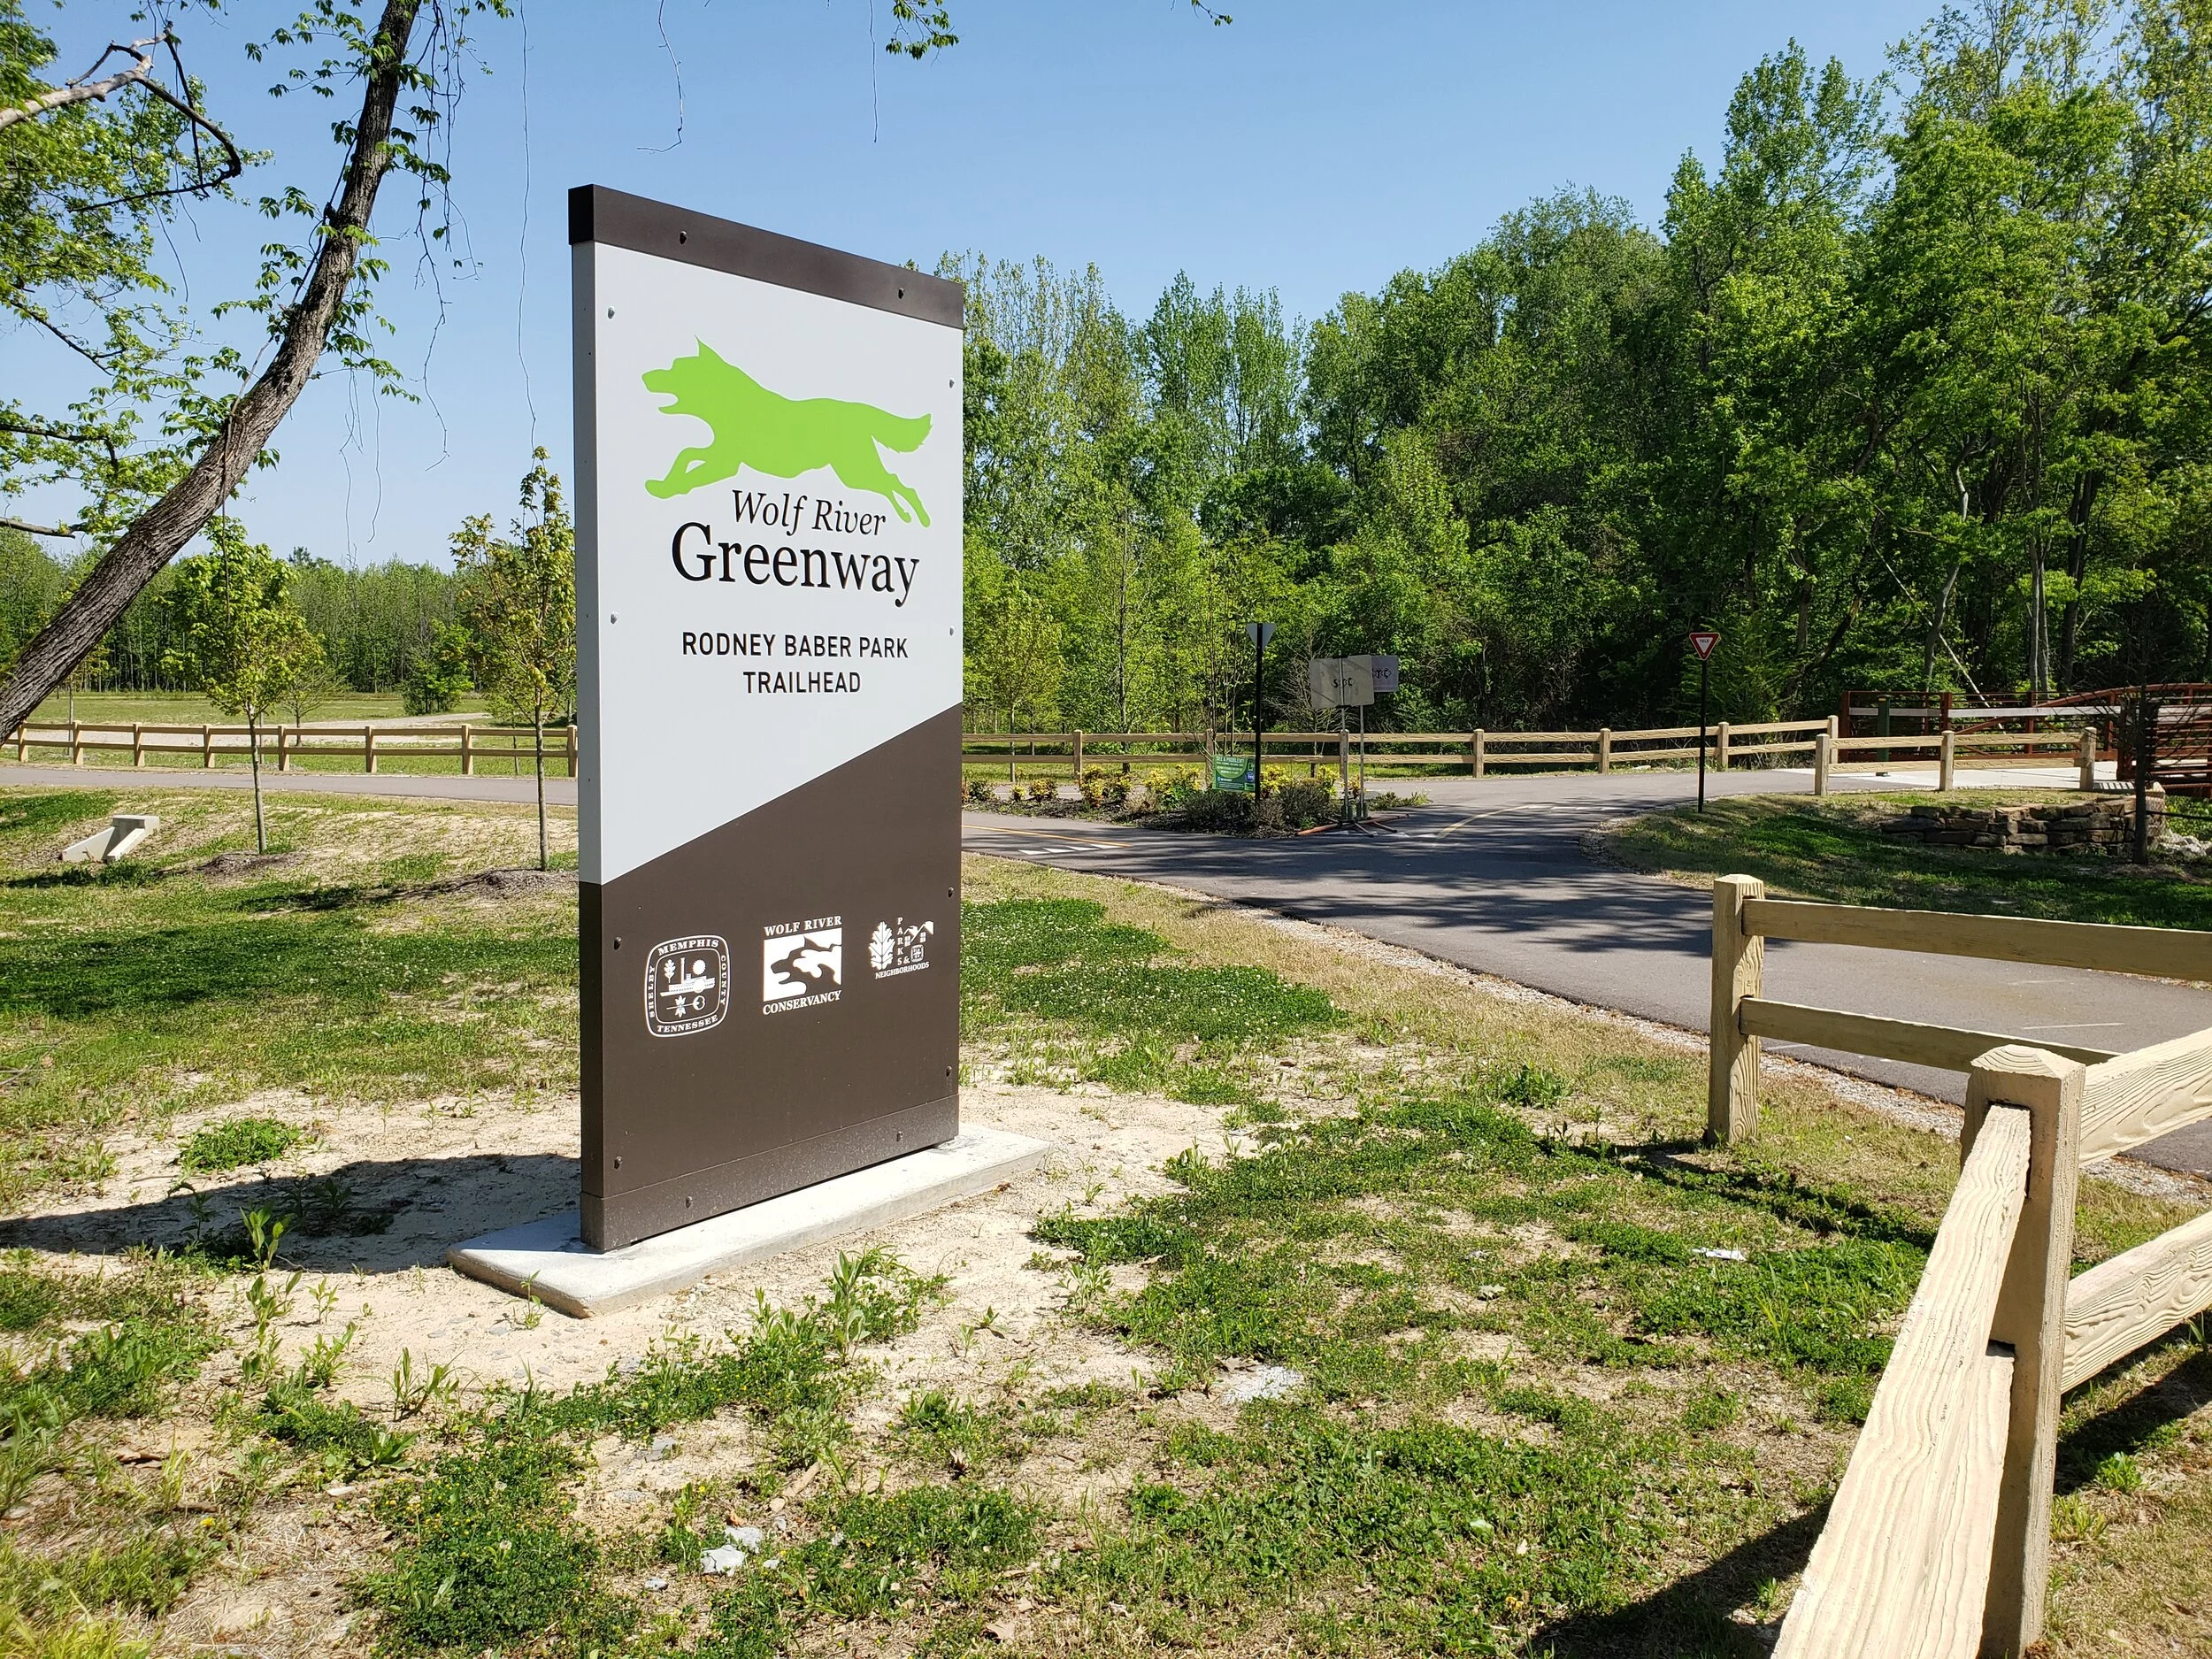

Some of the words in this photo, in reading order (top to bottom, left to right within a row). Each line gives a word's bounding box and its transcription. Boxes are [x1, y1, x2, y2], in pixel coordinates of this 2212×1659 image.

[732, 489, 807, 536] Wolf
[811, 499, 886, 535] River
[672, 522, 919, 607] Greenway
[682, 632, 776, 657] RODNEY
[785, 635, 851, 657] BABER
[859, 637, 909, 658] PARK
[743, 672, 861, 694] TRAILHEAD
[764, 922, 800, 936] WOLF
[804, 916, 842, 931] RIVER
[657, 939, 719, 956] MEMPHIS
[875, 961, 930, 979] NEIGHBORHOODS
[763, 990, 842, 1015] CONSERVANCY
[657, 1014, 718, 1033] TENNESSEE
